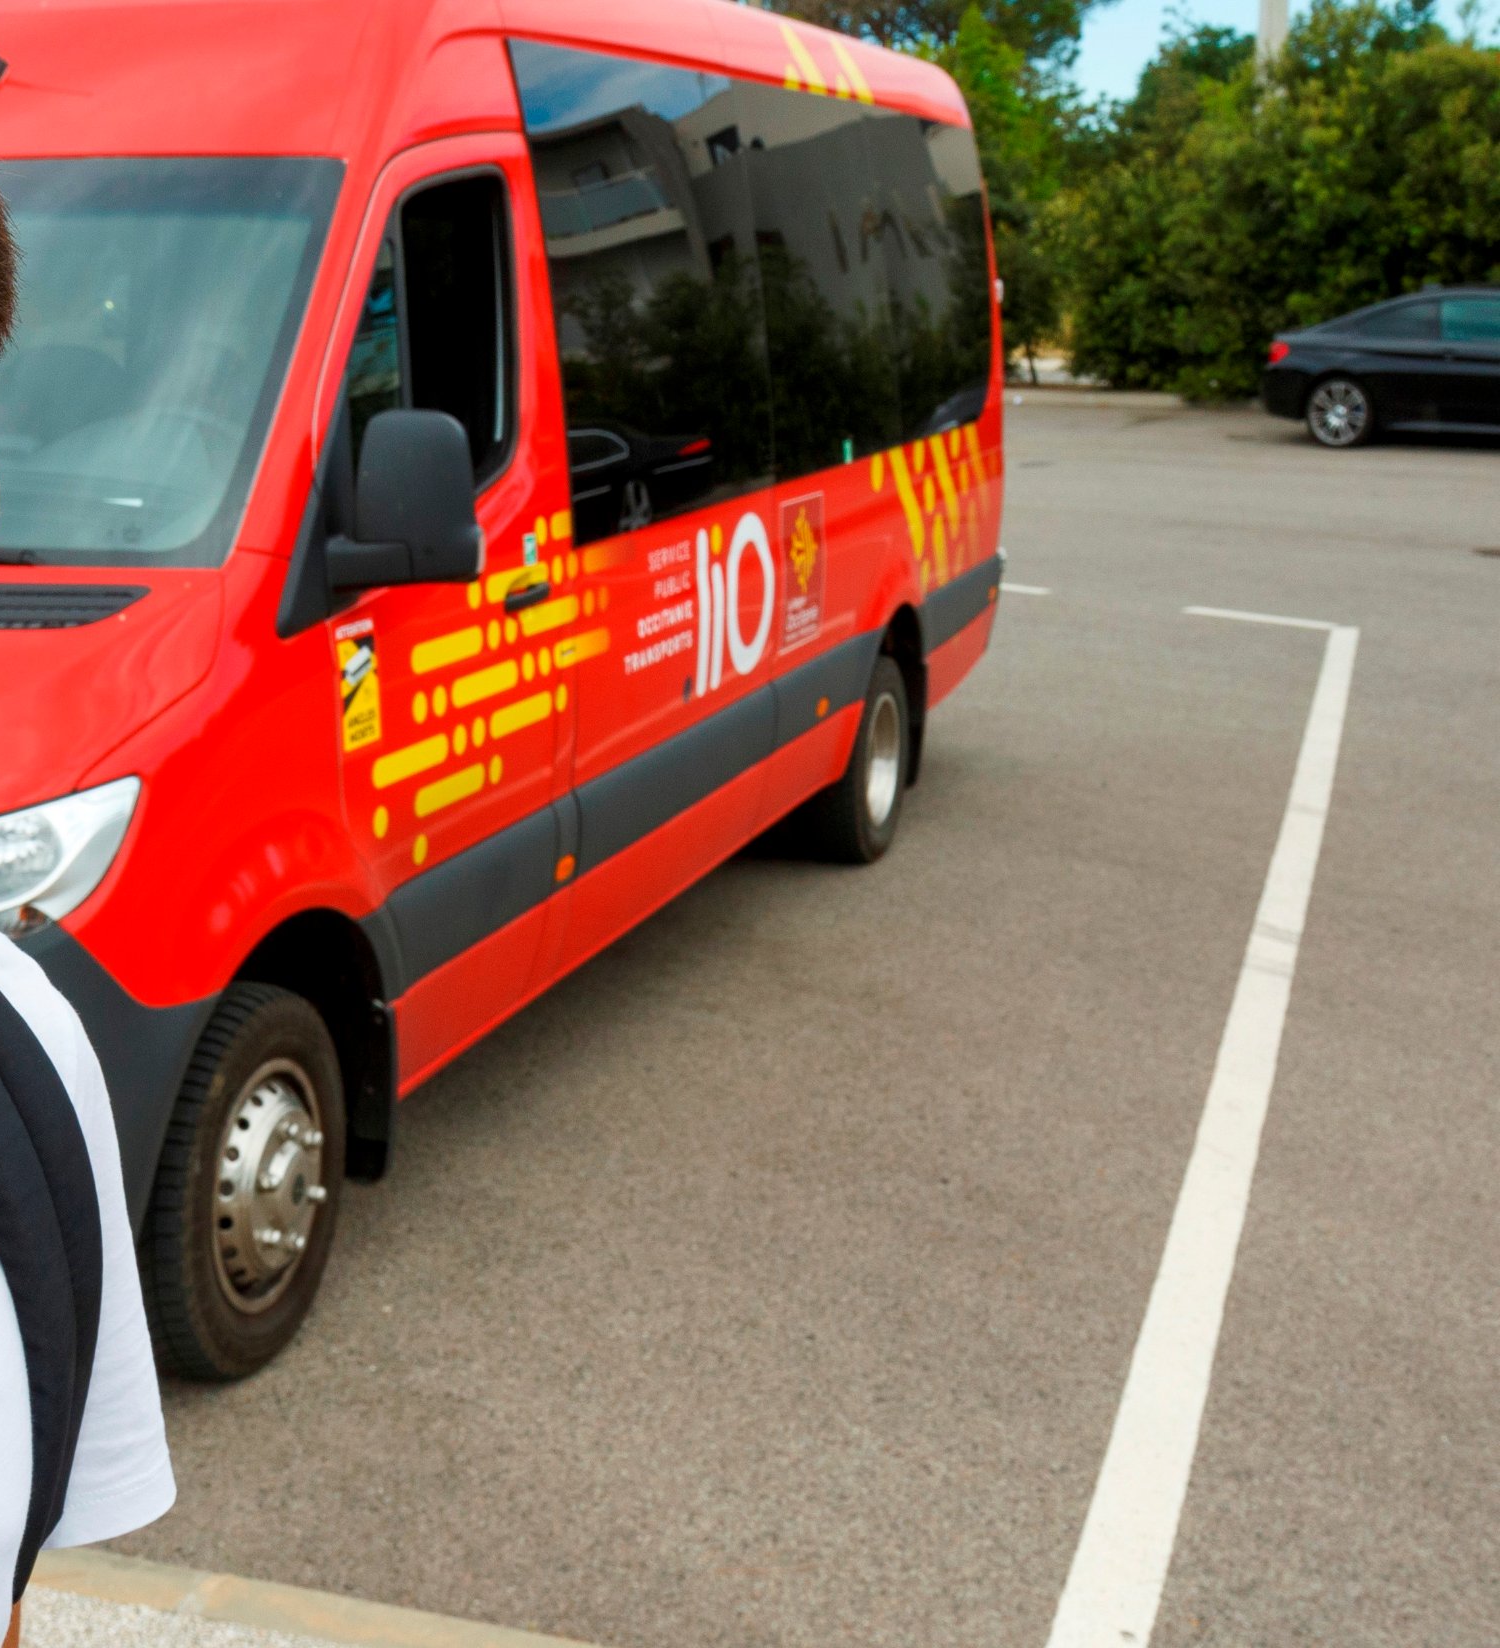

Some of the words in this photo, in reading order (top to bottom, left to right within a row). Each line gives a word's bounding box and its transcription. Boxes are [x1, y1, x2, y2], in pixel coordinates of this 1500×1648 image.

[647, 540, 690, 572] SERVICE
[654, 570, 691, 599] PUBLIC
[637, 600, 693, 639] OCCITANIE
[624, 629, 693, 675] TRANSPORTS
